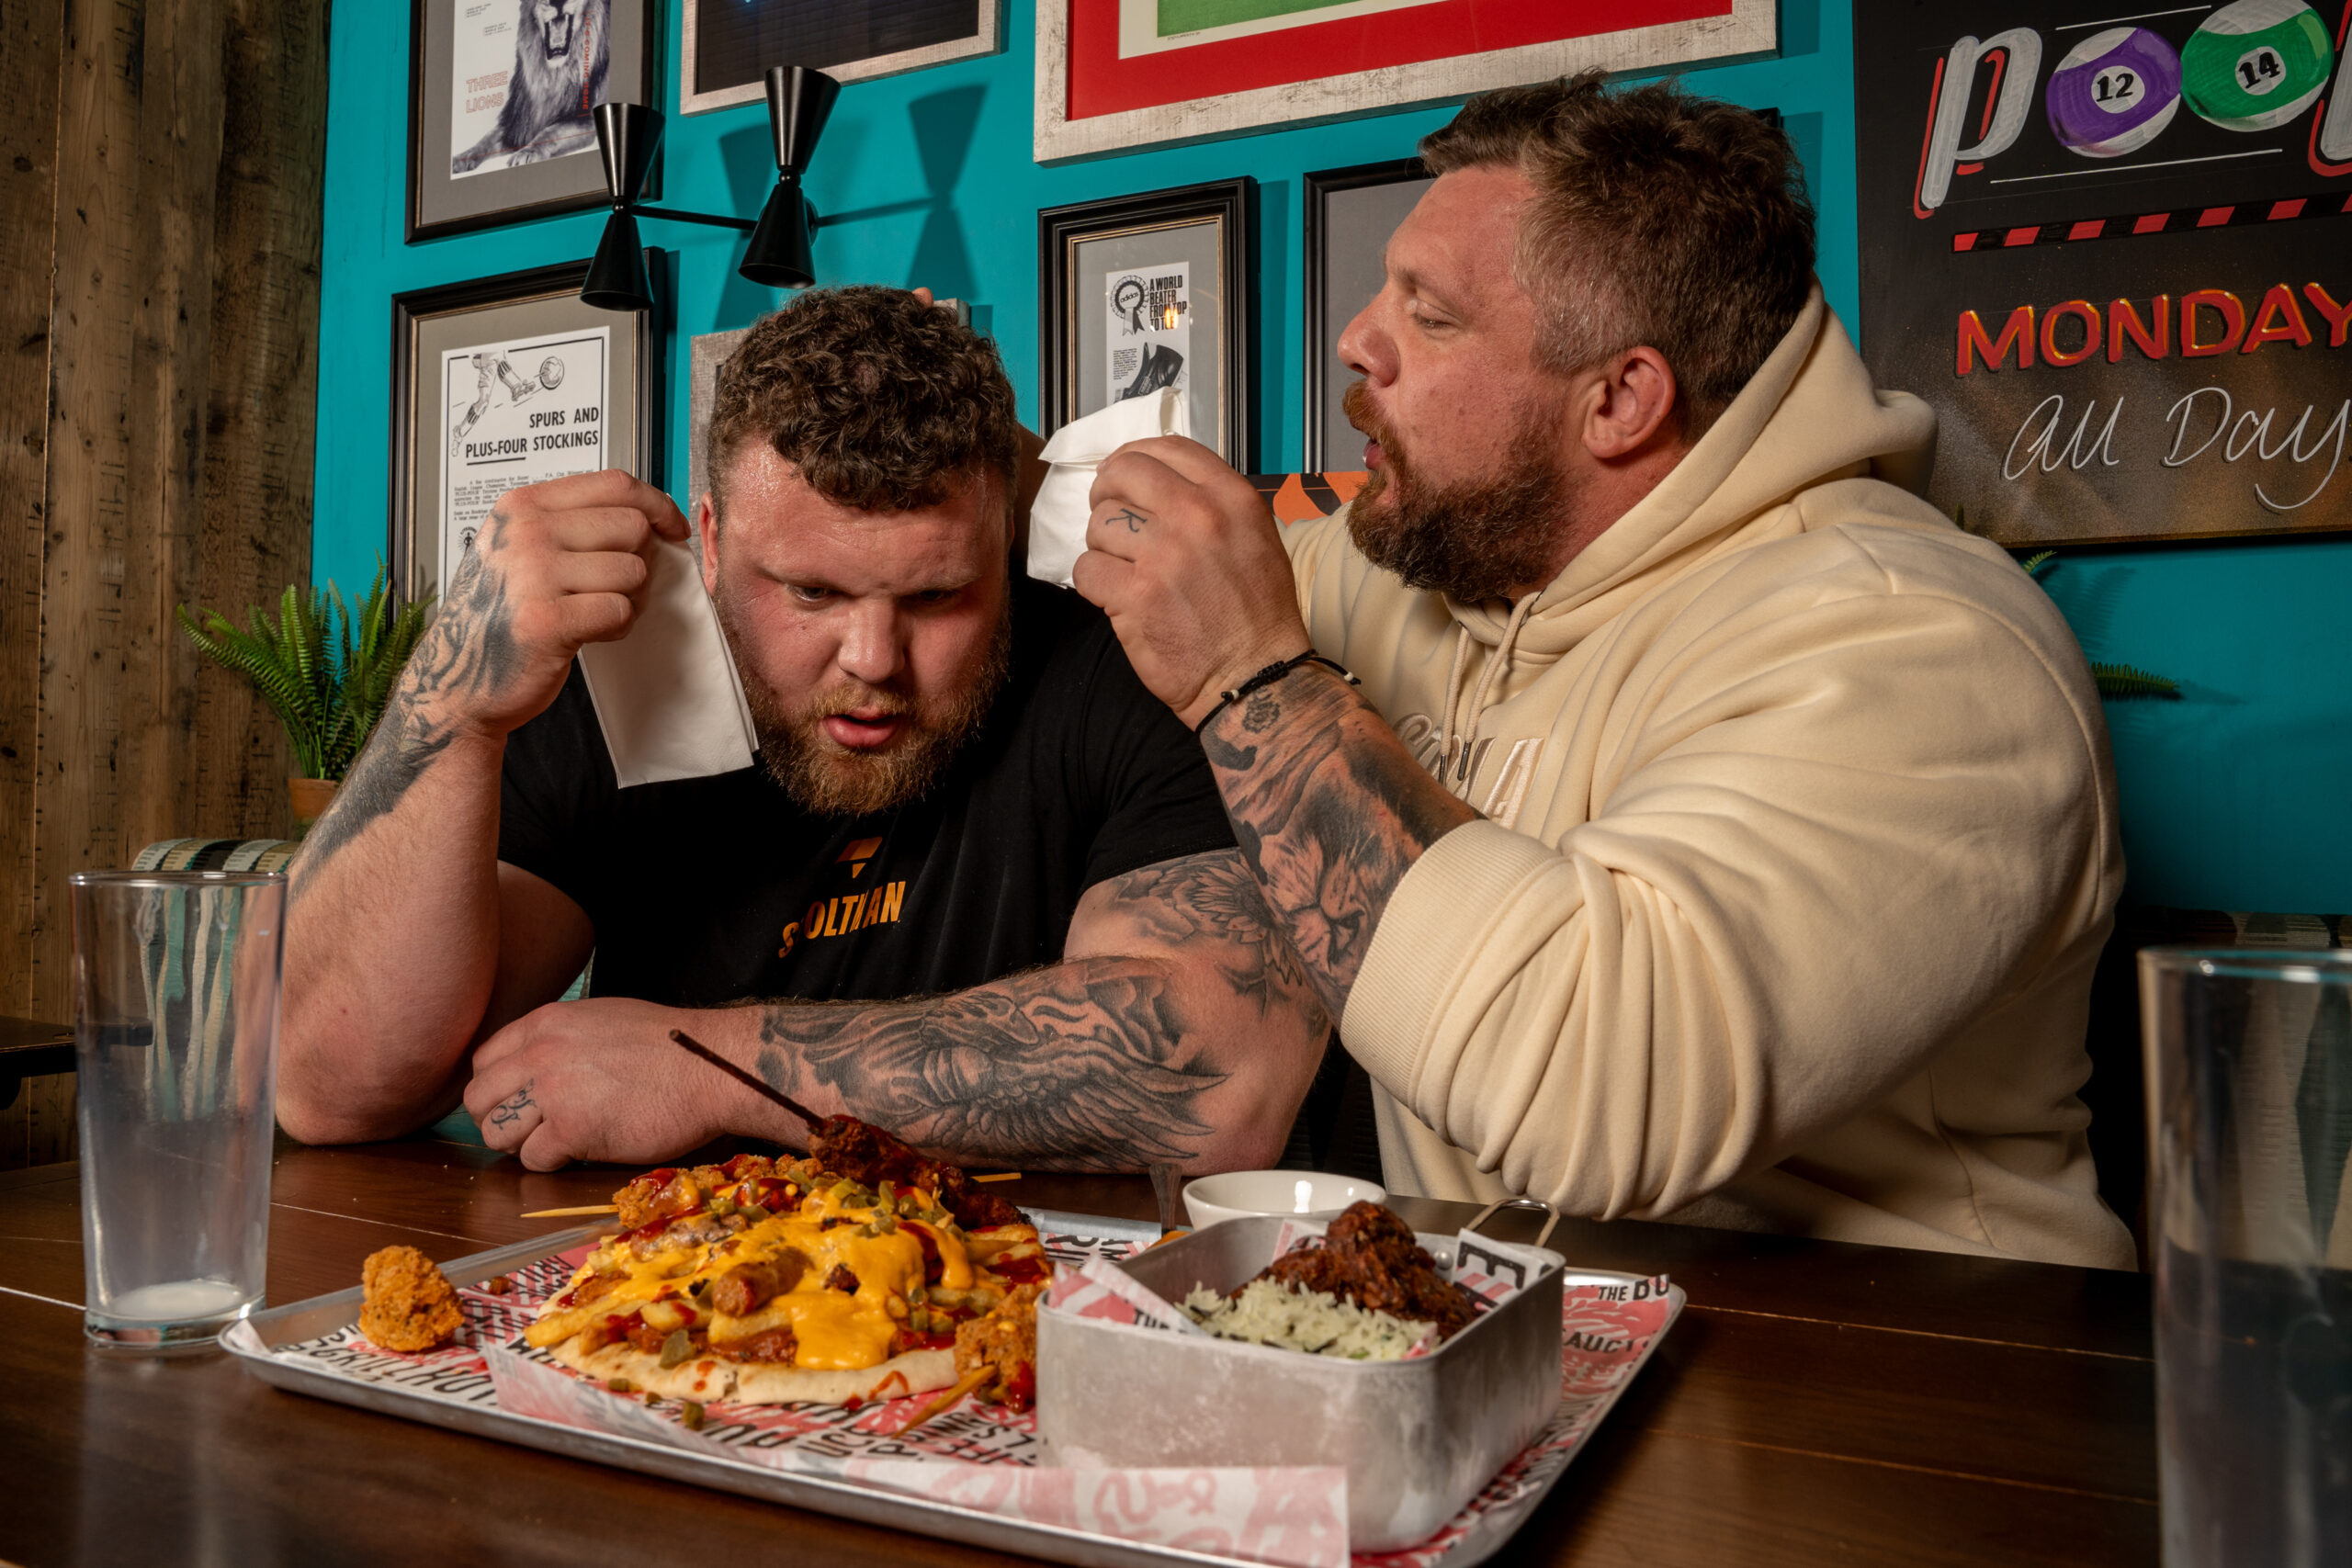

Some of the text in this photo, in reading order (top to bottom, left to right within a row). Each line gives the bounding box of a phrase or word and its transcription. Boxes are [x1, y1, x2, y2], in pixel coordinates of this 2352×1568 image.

[2237, 51, 2280, 89] 14
[466, 71, 508, 93] THREE
[2096, 72, 2134, 103] 12
[466, 92, 504, 114] LIONS
[1156, 275, 1182, 290] WORLD
[1150, 289, 1176, 305] BEATER
[529, 406, 599, 429] SPURS AND
[466, 430, 598, 458] PLUS-FOUR STOCKINGS
[1599, 1285, 1629, 1302] THE
